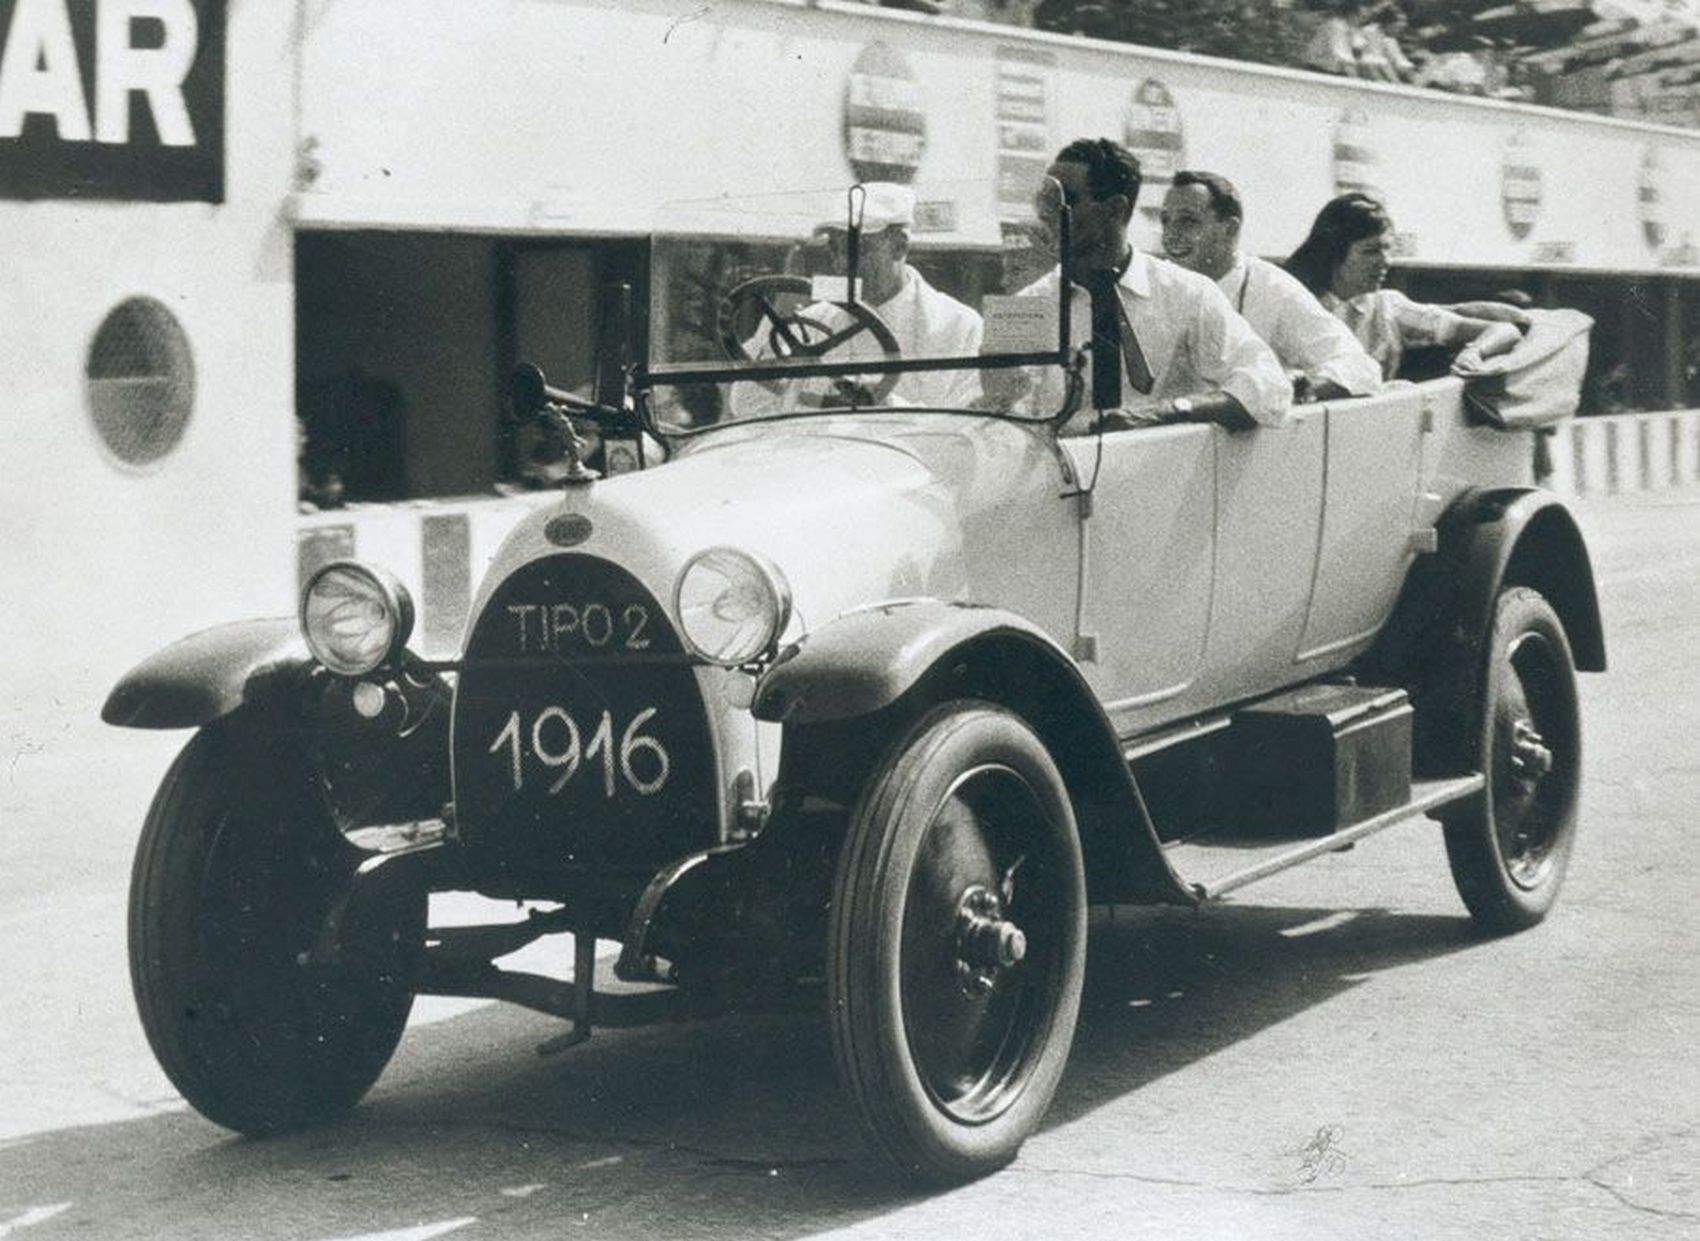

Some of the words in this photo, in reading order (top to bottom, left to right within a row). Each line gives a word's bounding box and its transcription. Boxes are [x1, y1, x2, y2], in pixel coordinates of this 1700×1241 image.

[0, 0, 197, 146] AR
[507, 603, 612, 651] TIPO
[623, 604, 651, 649] 2
[489, 706, 670, 797] 1916
